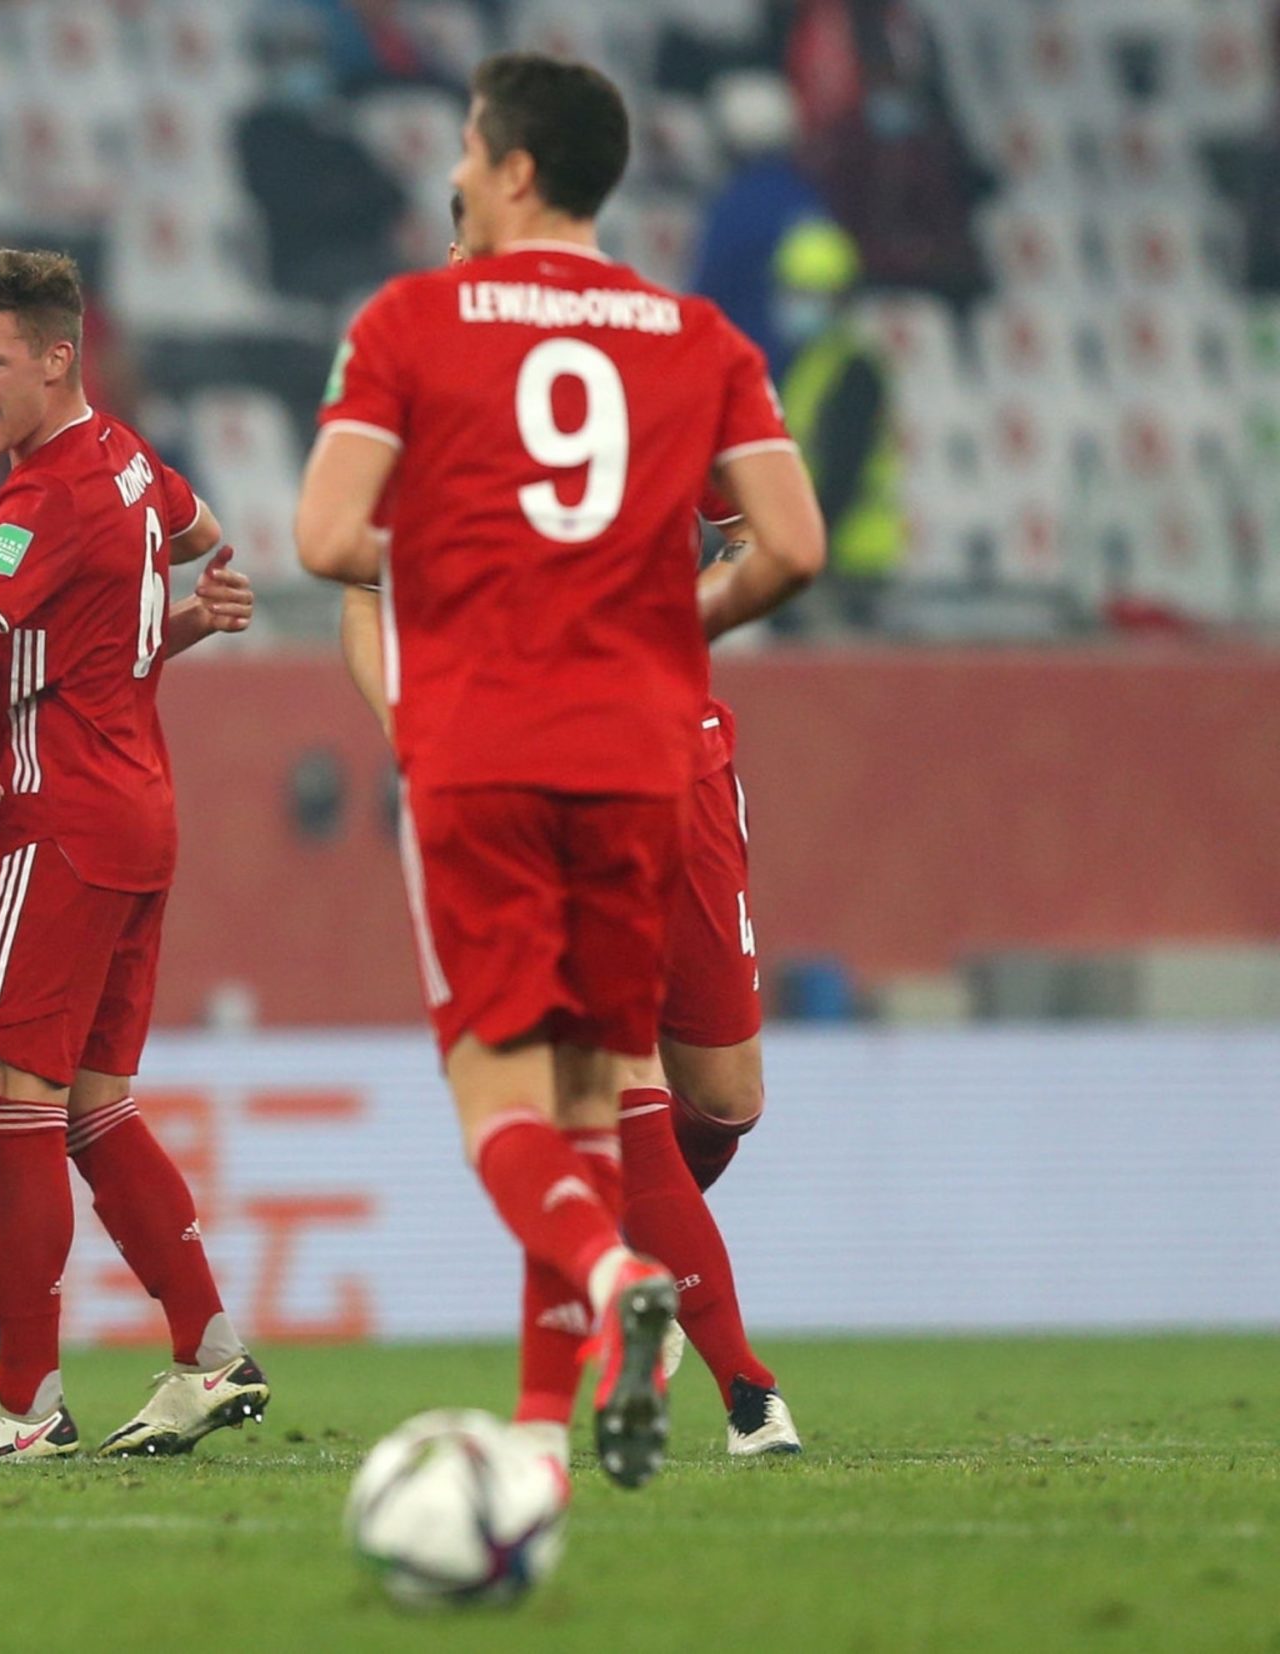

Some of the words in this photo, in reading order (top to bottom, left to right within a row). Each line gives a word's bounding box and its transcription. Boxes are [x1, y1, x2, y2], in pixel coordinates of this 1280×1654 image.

[458, 282, 683, 335] LEWANDOWSKI
[516, 337, 629, 543] 9
[132, 506, 166, 679] 6
[737, 890, 756, 958] 4
[673, 1273, 702, 1293] CB
